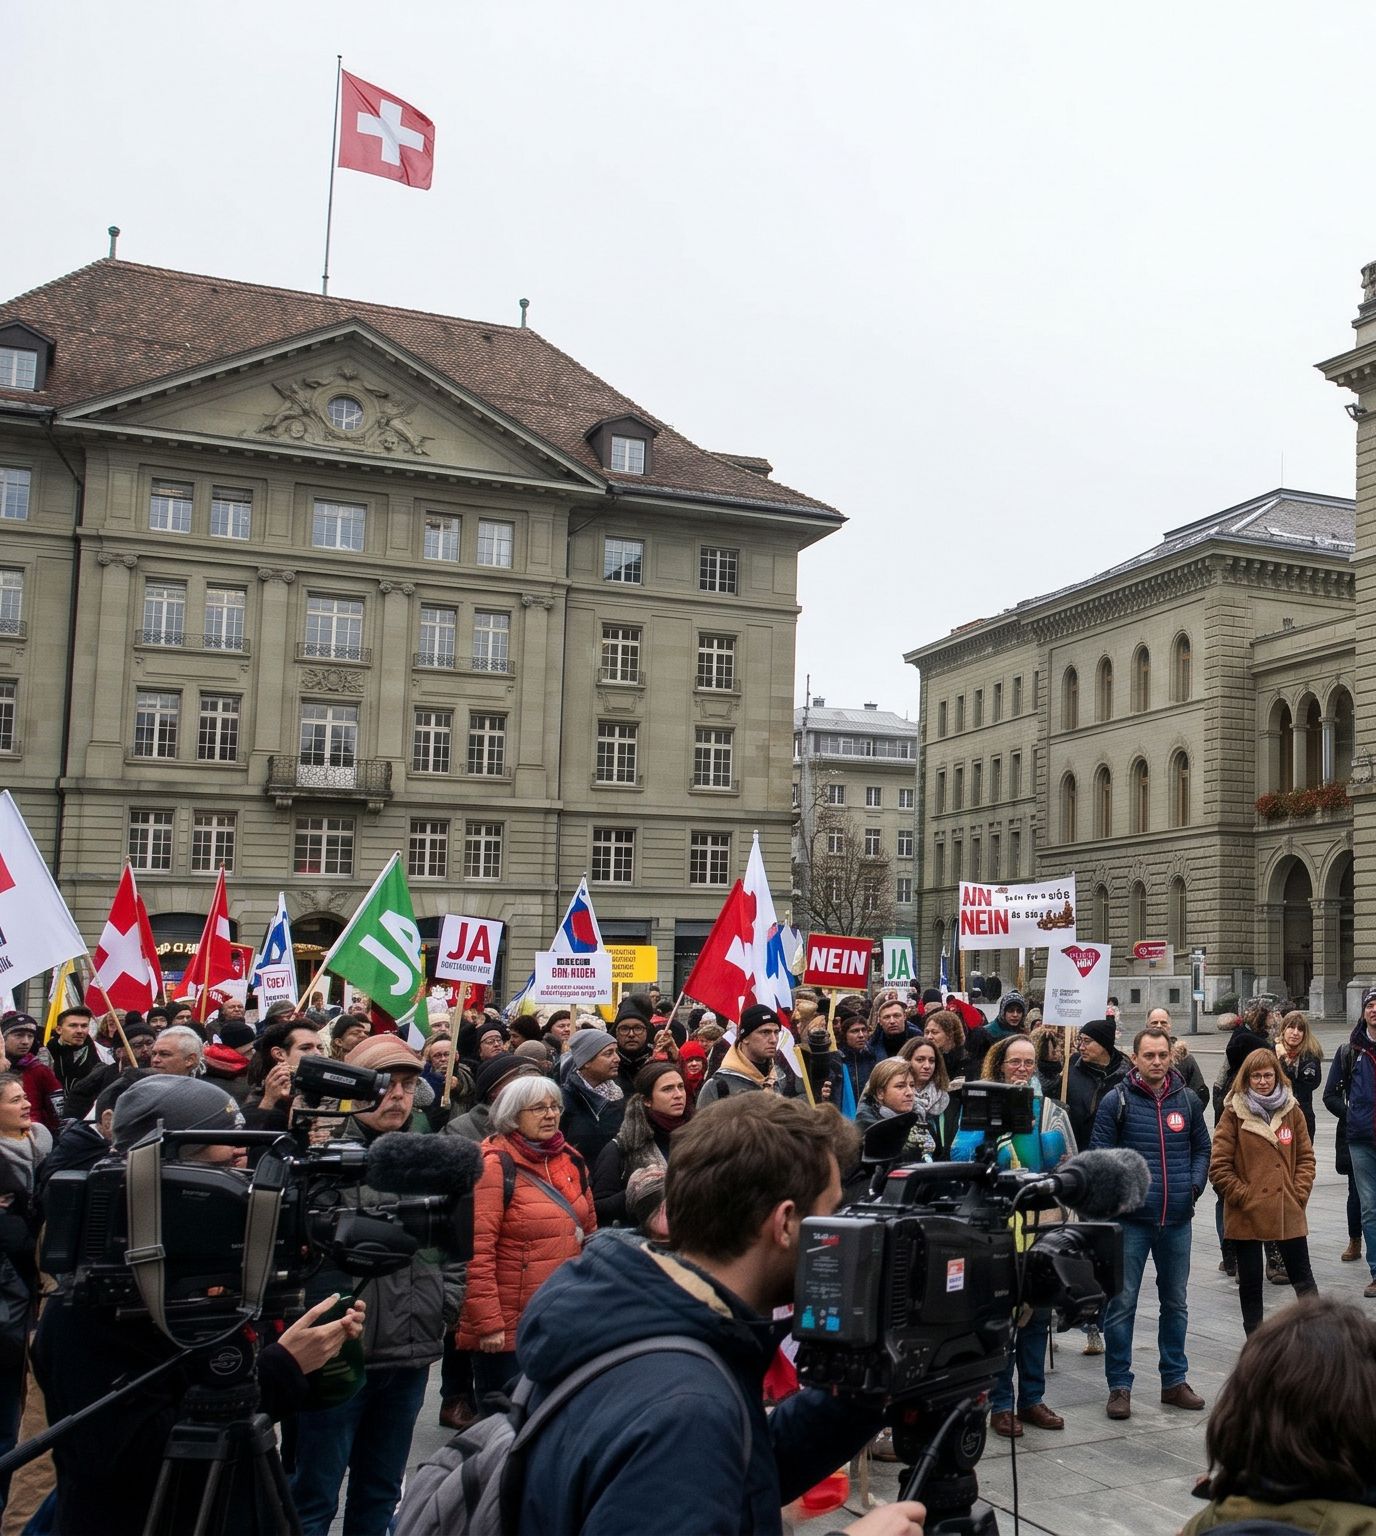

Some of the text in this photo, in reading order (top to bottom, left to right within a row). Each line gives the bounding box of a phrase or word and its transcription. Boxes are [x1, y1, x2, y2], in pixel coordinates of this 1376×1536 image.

[961, 909, 1009, 935] NEIN
[358, 909, 422, 996] JA
[446, 922, 492, 964] JA
[809, 946, 867, 975] NEIN
[887, 948, 911, 980] JA
